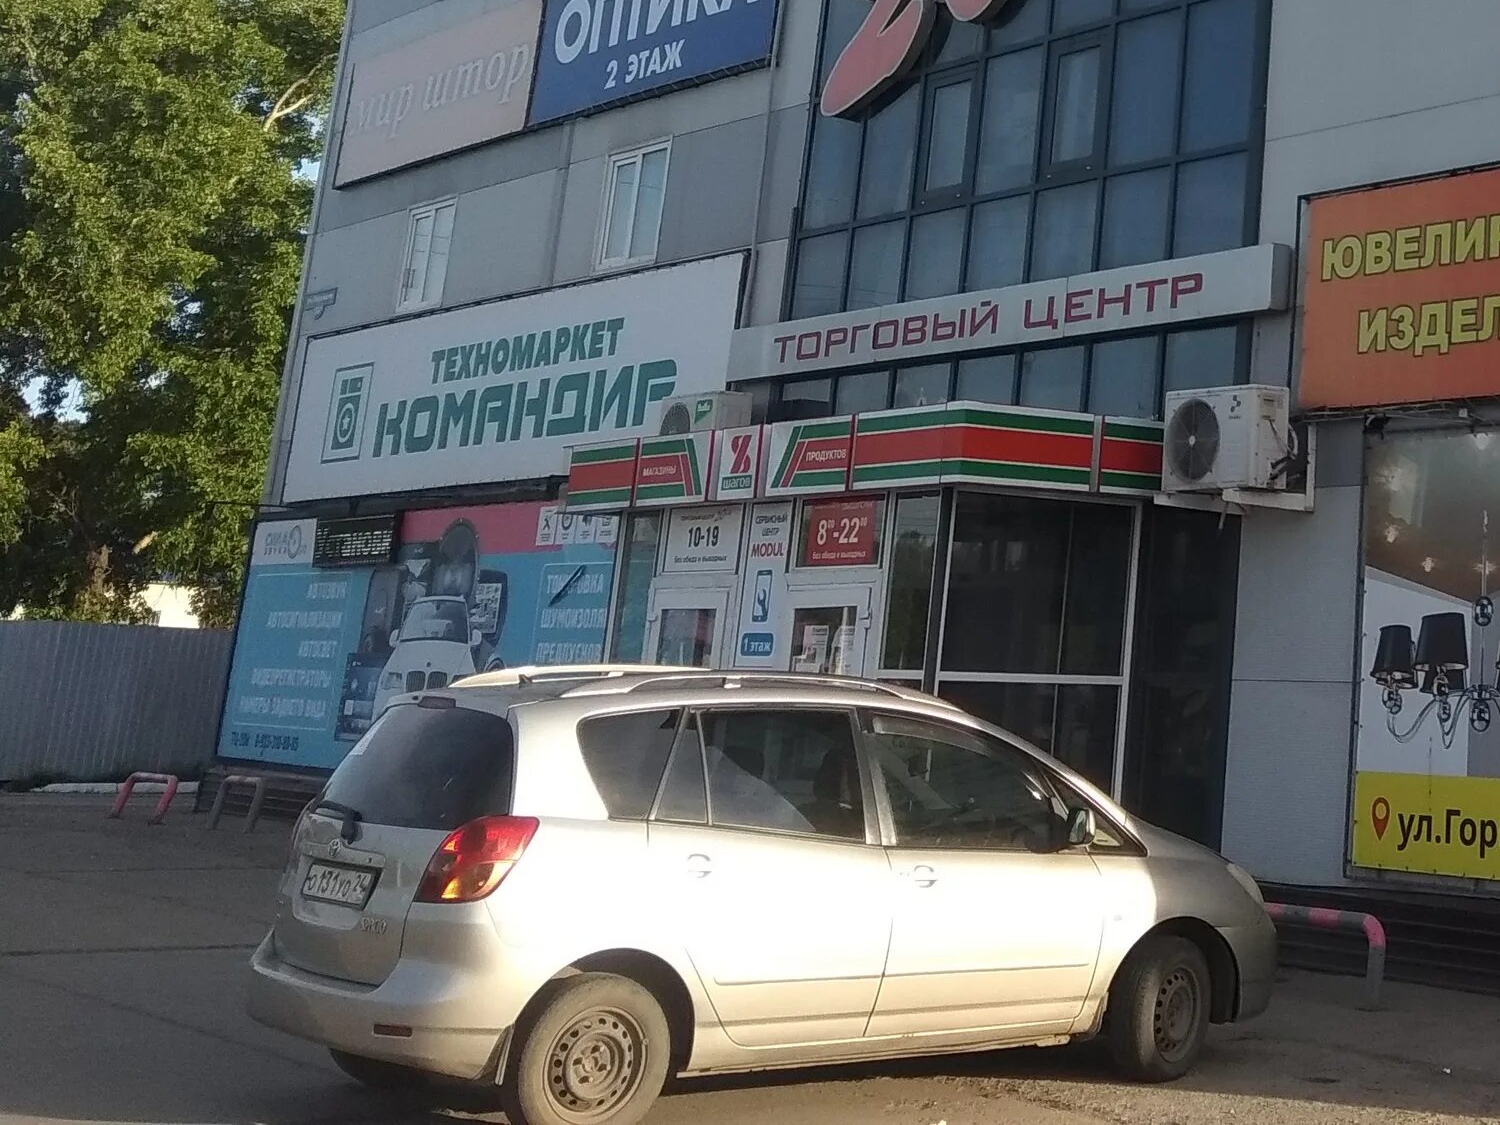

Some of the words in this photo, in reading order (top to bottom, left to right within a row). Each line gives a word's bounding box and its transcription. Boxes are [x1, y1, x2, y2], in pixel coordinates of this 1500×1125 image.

[604, 60, 618, 90] 2
[625, 39, 685, 83] ЭТАЖ
[423, 43, 530, 111] штор
[773, 300, 1000, 363] ТОРГОВЫЙ
[1023, 272, 1204, 330] ЦЕНТР
[431, 317, 625, 384] ТЕХНОМАРКЕТ
[372, 359, 677, 458] КОМАНДИР
[805, 448, 847, 462] ПРОДУКТОВ
[642, 465, 676, 475] МАГАЗИНЫ
[723, 477, 750, 489] шагов
[688, 525, 720, 548] 10-19
[751, 542, 784, 558] MODUL
[743, 638, 749, 651] 1
[750, 638, 771, 652] этаж
